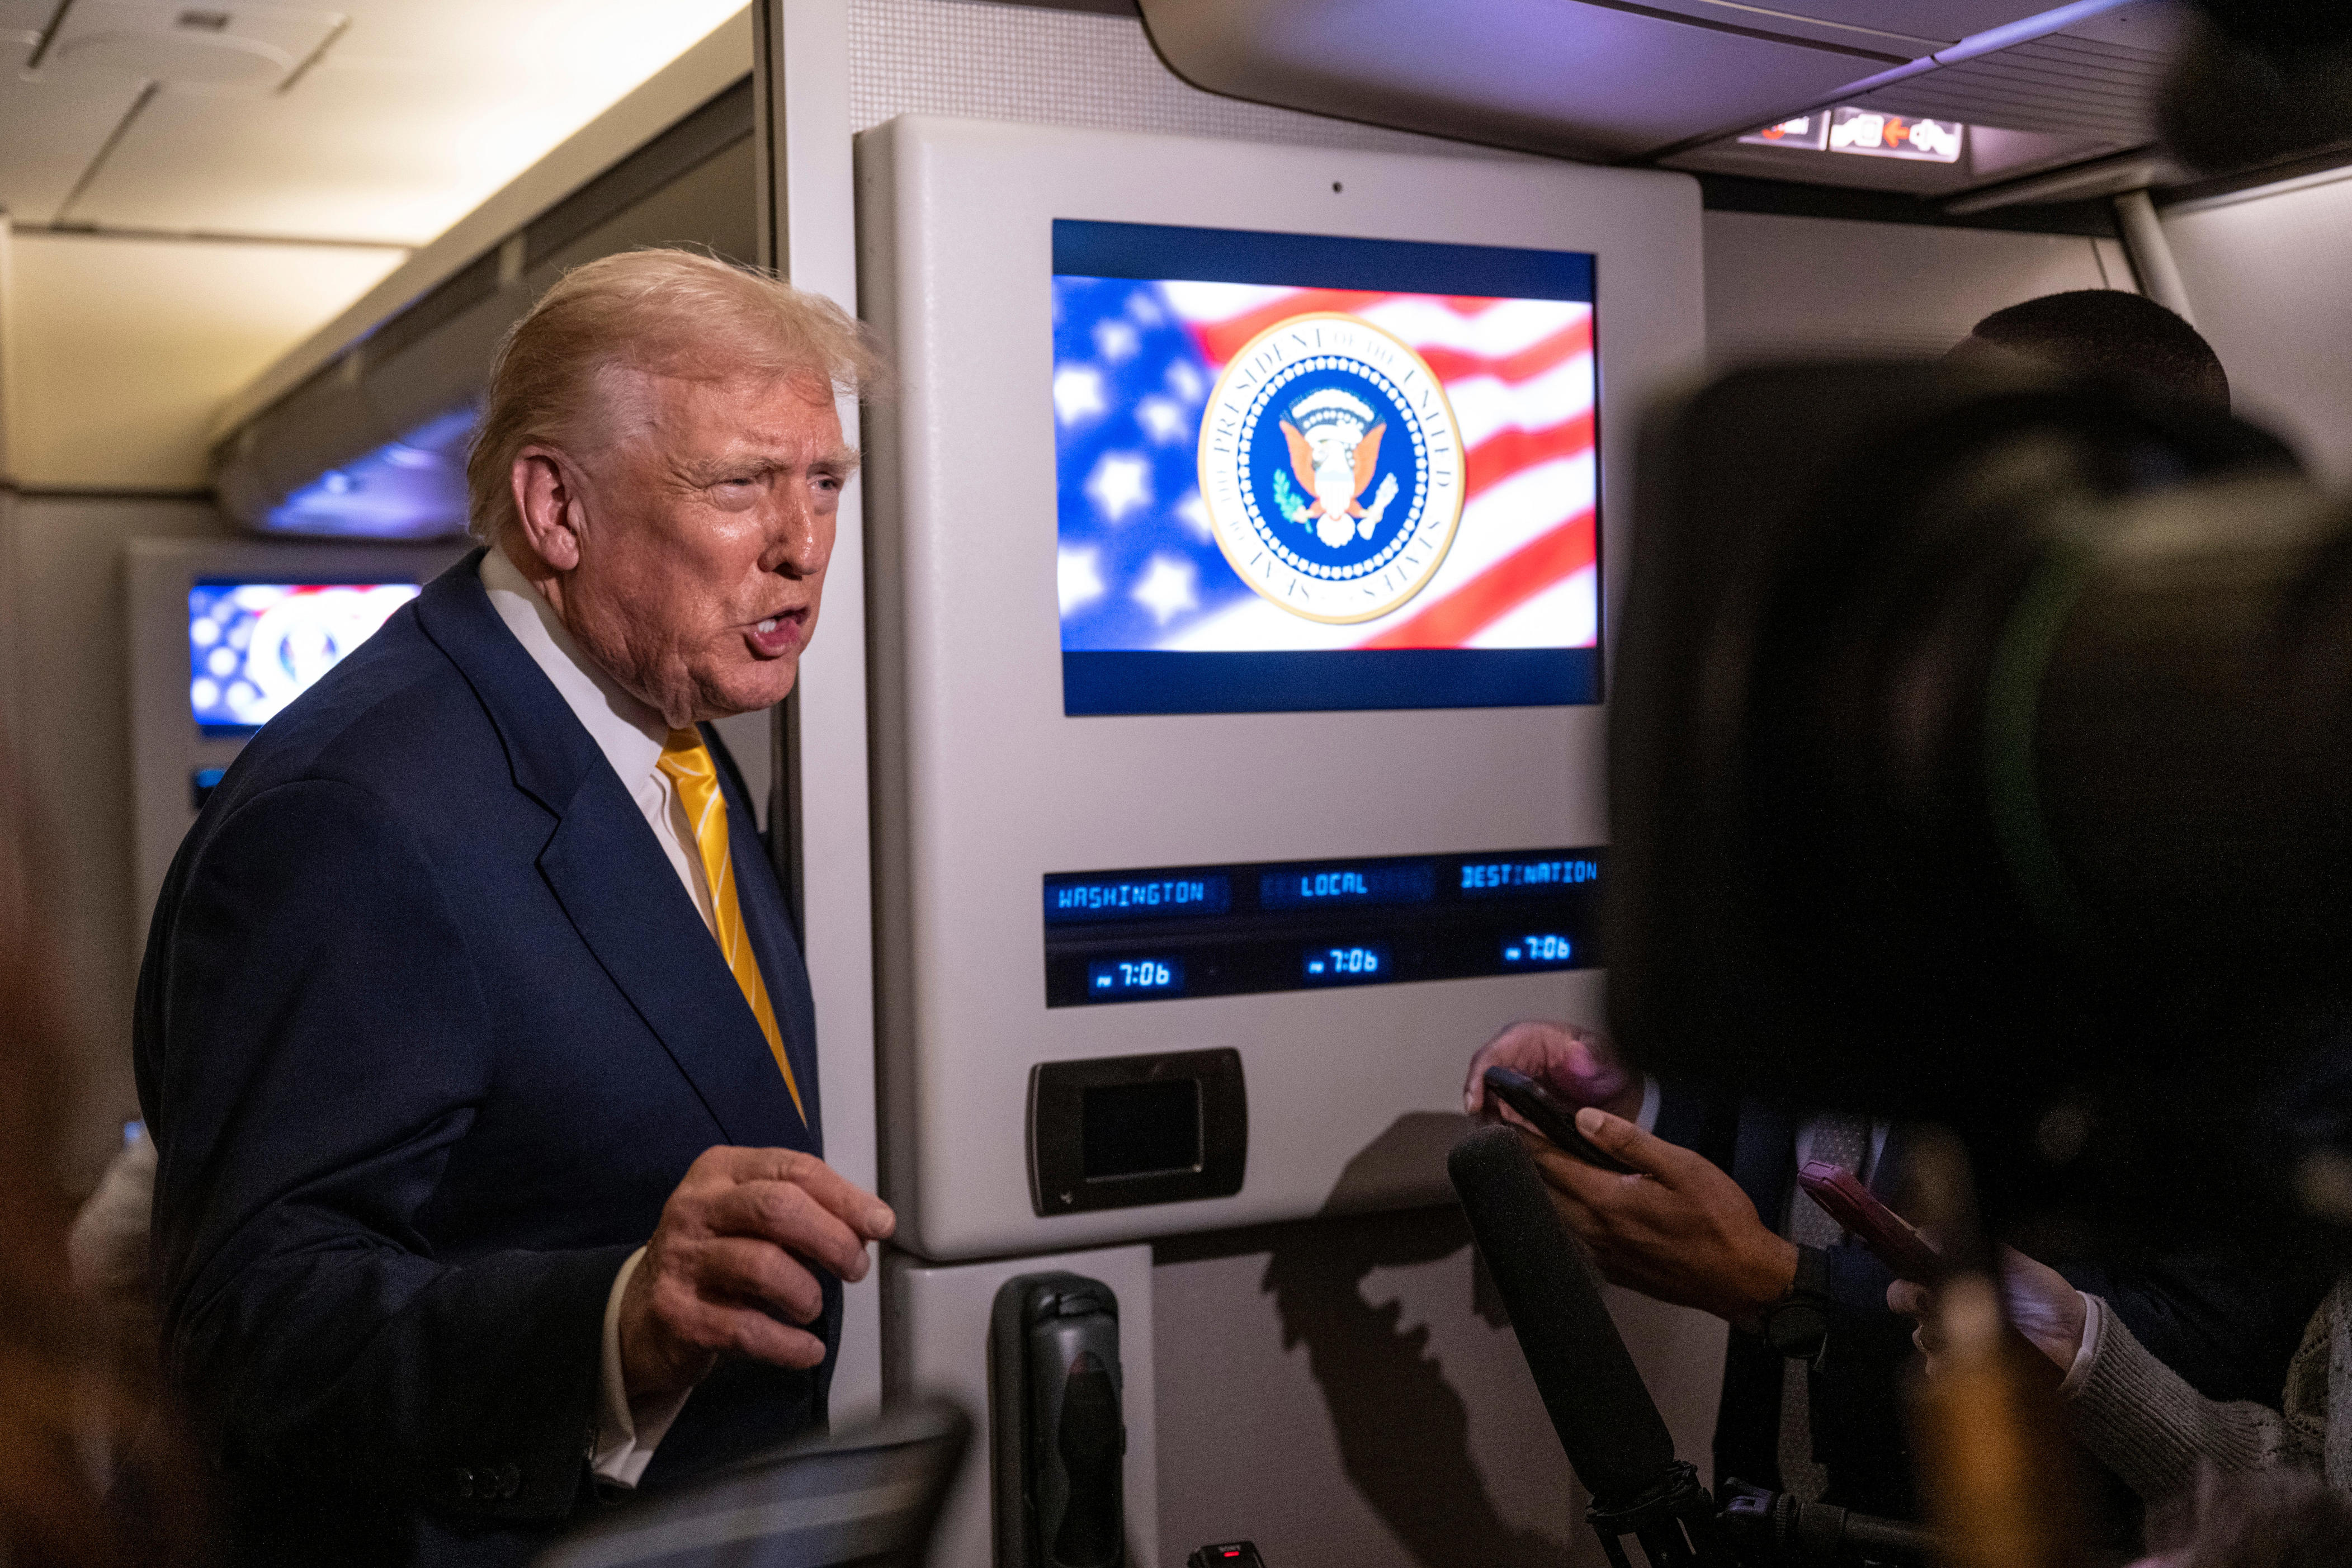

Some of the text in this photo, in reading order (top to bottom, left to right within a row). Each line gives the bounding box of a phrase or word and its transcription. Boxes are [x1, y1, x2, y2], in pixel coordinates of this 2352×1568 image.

[1301, 872, 1368, 896] LOCAL
[1461, 861, 1597, 888] DESTINATION
[1059, 881, 1203, 908] WASHINGTON
[1330, 948, 1378, 972] 7:06
[1526, 935, 1570, 960] 7:06
[1119, 961, 1170, 986] 7:06
